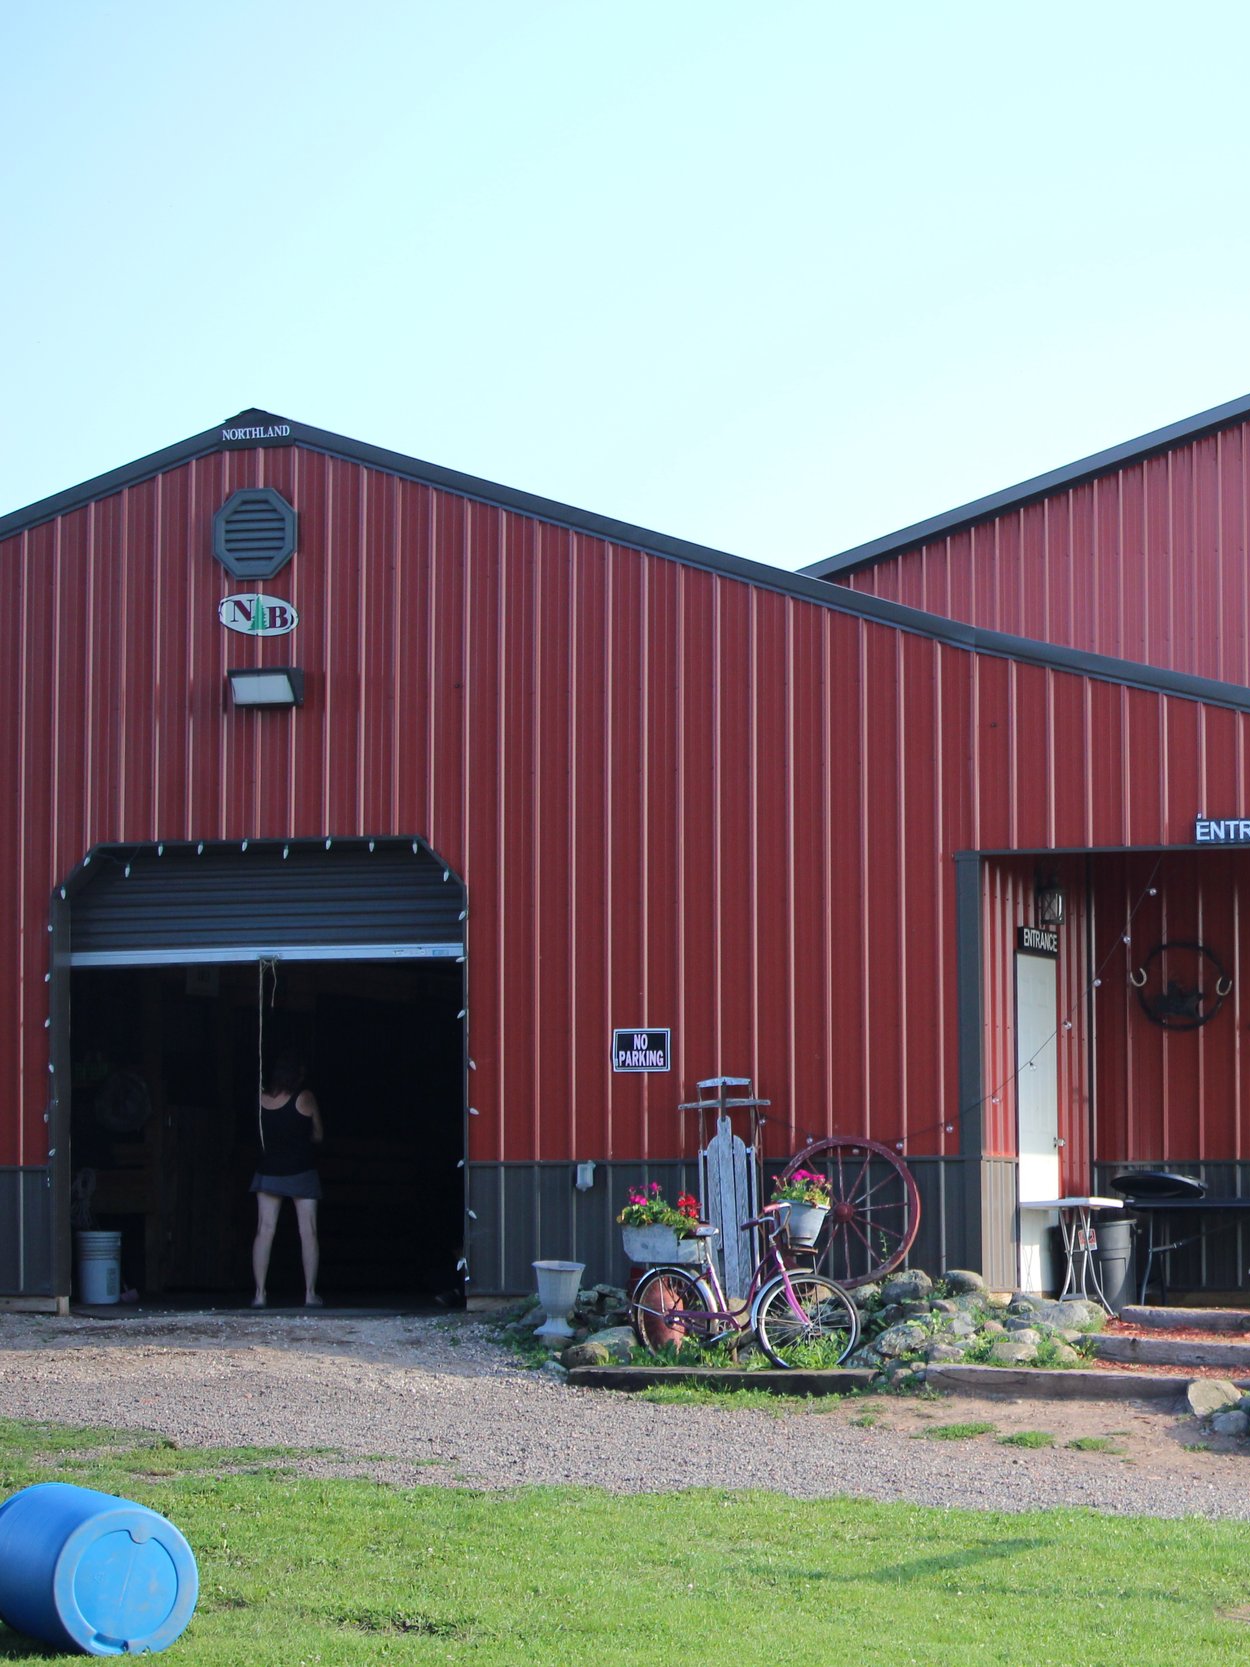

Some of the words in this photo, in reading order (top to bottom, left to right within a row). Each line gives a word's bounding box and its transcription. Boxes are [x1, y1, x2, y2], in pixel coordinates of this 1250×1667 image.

[222, 424, 290, 441] NORTHLAND
[1023, 928, 1058, 953] ENTRANCE
[633, 1033, 648, 1051] NO
[618, 1050, 664, 1067] PARKING
